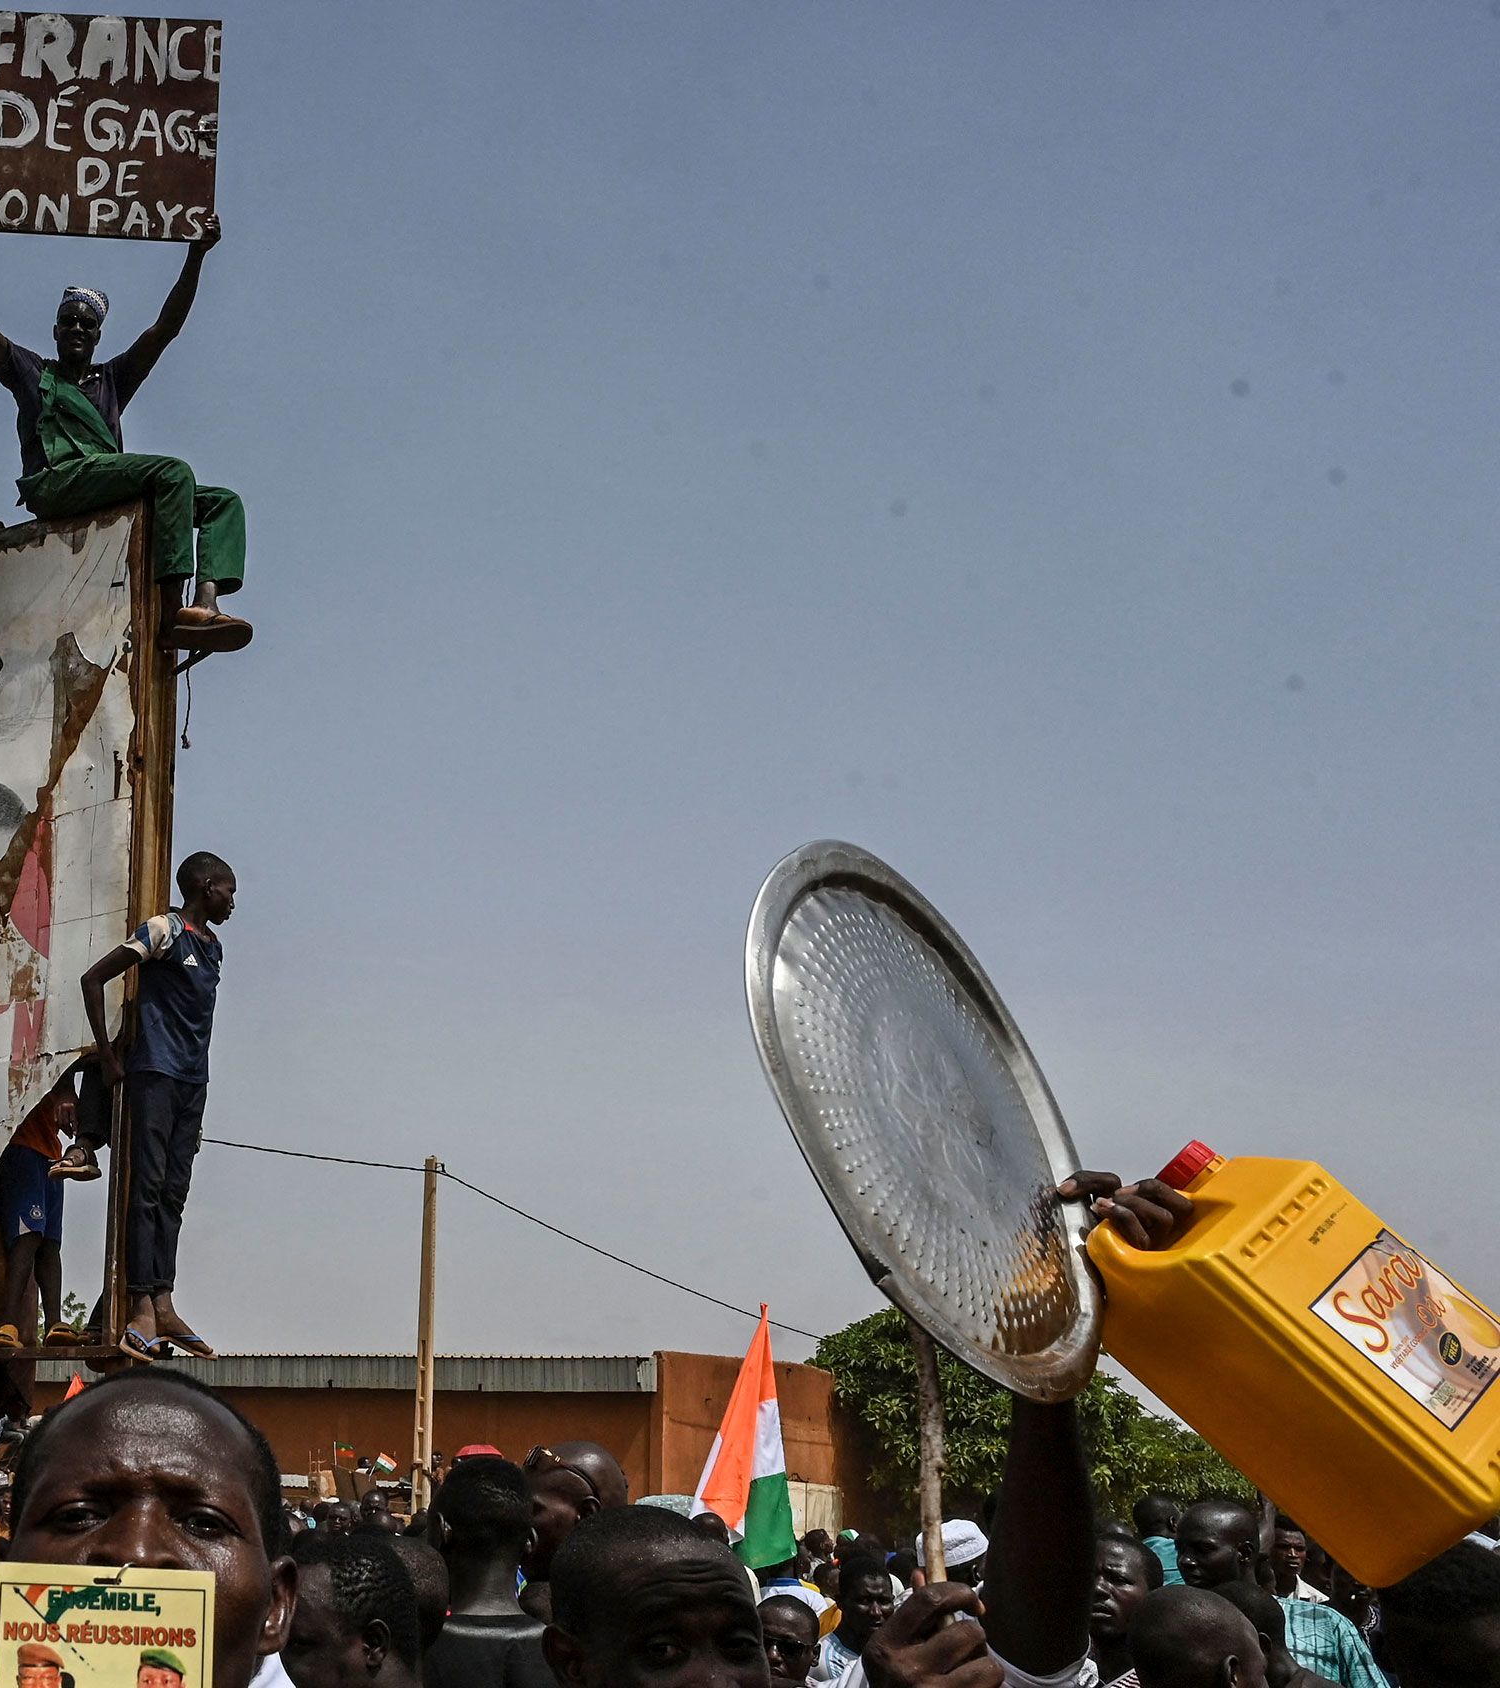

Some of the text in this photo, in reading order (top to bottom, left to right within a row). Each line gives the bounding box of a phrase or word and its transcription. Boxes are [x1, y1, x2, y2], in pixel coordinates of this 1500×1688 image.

[77, 156, 145, 197] DE
[88, 198, 207, 240] PAYS
[1334, 1253, 1421, 1352] Sara
[1417, 1296, 1446, 1327] Oil
[1448, 1339, 1459, 1361] FREE
[48, 1589, 161, 1616] ENSEMBLE,
[3, 1620, 197, 1648] NOUS RÉUSSIRONS
